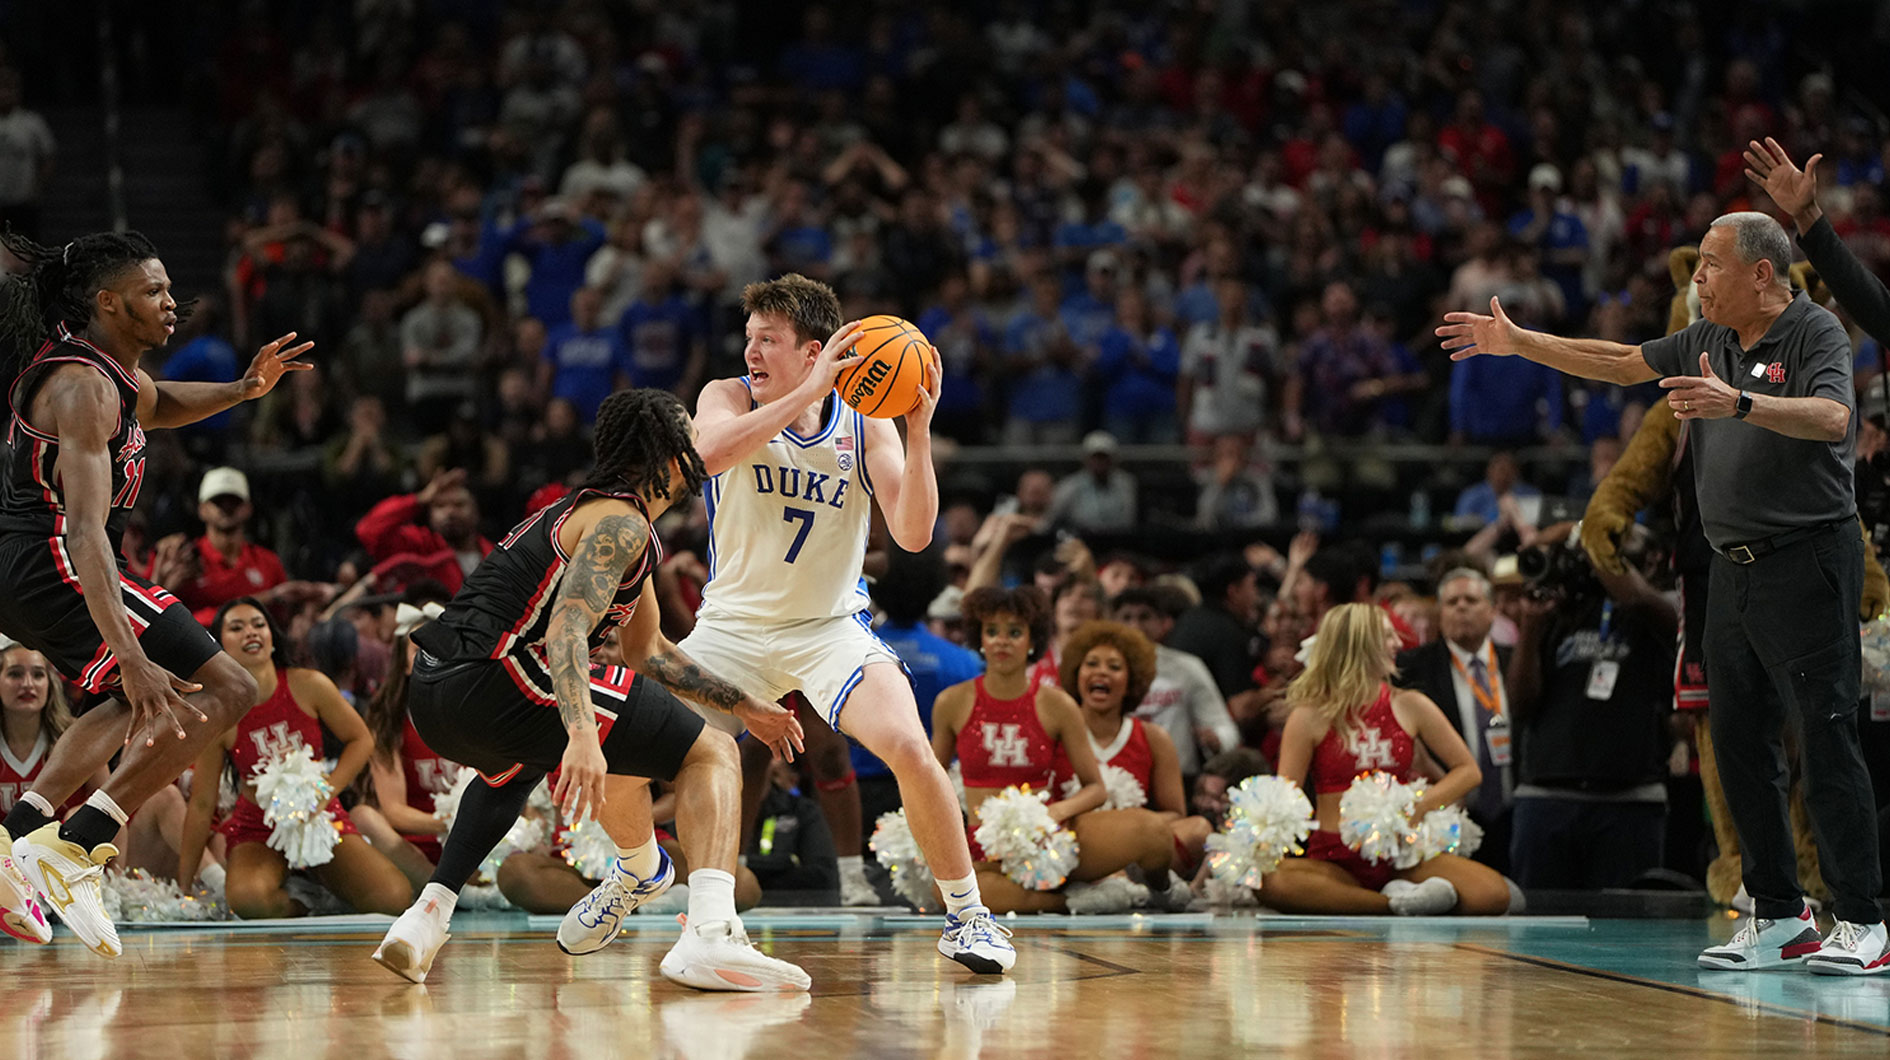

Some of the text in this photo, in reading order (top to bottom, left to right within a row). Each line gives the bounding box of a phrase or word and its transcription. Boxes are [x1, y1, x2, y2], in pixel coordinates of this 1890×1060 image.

[847, 359, 893, 409] Wilson
[1766, 361, 1785, 383] UH
[111, 457, 146, 508] 11
[752, 464, 849, 509] DUKE
[783, 505, 815, 564] 7
[981, 722, 1030, 767] UH
[1349, 727, 1396, 769] UH
